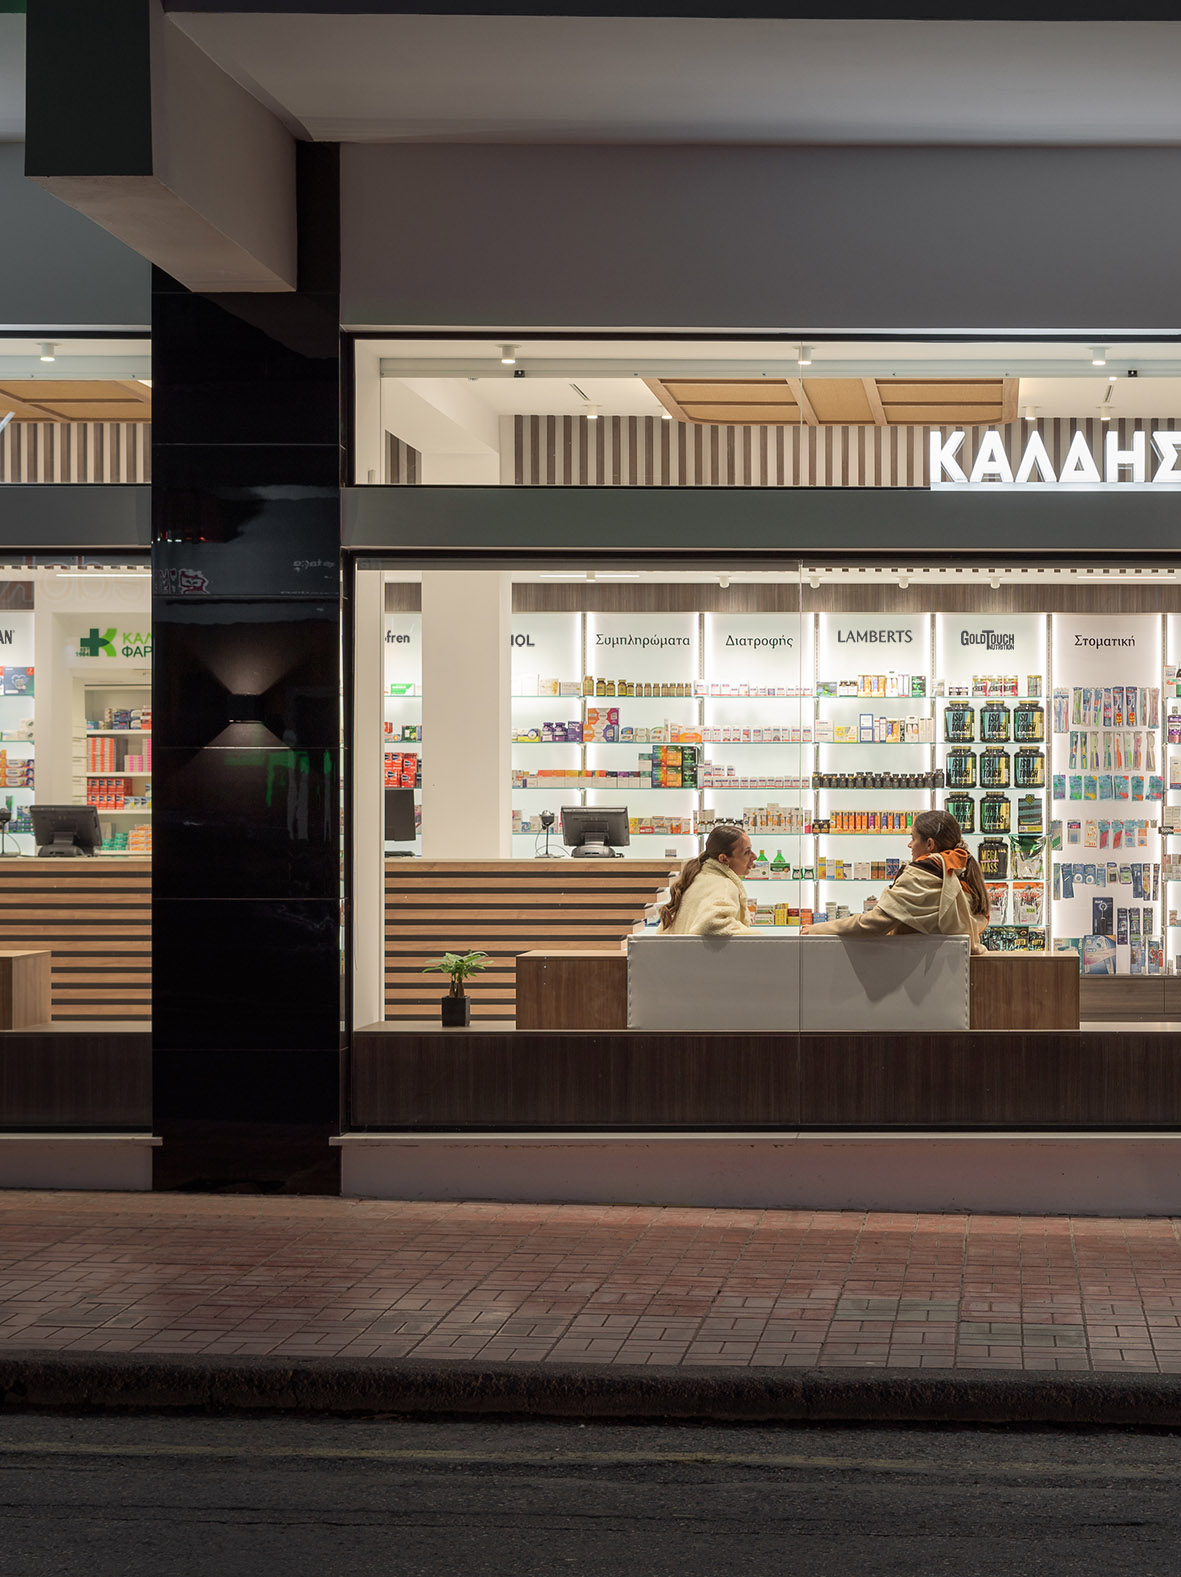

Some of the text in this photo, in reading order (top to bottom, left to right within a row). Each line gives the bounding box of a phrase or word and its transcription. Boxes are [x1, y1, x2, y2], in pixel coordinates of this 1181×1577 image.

[384, 630, 411, 644] fren
[596, 633, 690, 649] Συμπληρώματα
[725, 634, 794, 649] Διατροφής
[837, 629, 913, 644] LAMBERTS
[1074, 634, 1136, 649] Στοματική
